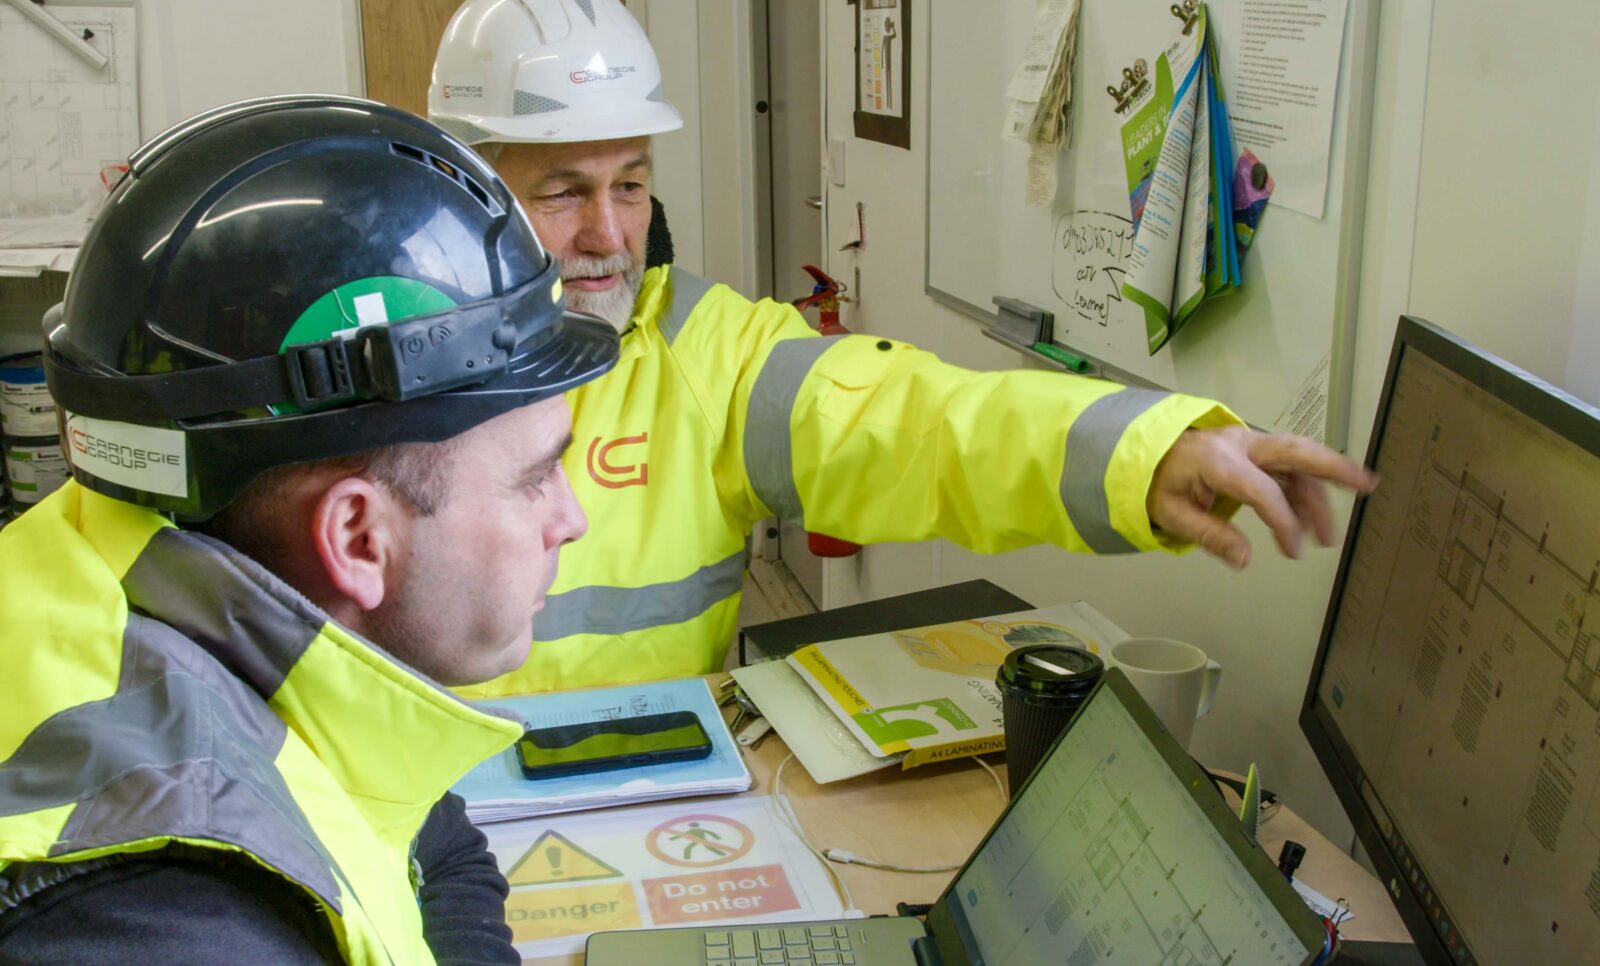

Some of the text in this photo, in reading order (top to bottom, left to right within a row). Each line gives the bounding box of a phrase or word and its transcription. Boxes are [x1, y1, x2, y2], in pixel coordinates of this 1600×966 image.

[1127, 129, 1153, 161] PLANT
[86, 434, 180, 466] CARNEGIE
[88, 445, 147, 470] GROUP
[930, 739, 1006, 760] A4 LAMINATING
[662, 874, 770, 899] Do not
[507, 896, 620, 923] Danger
[681, 893, 763, 914] enter
